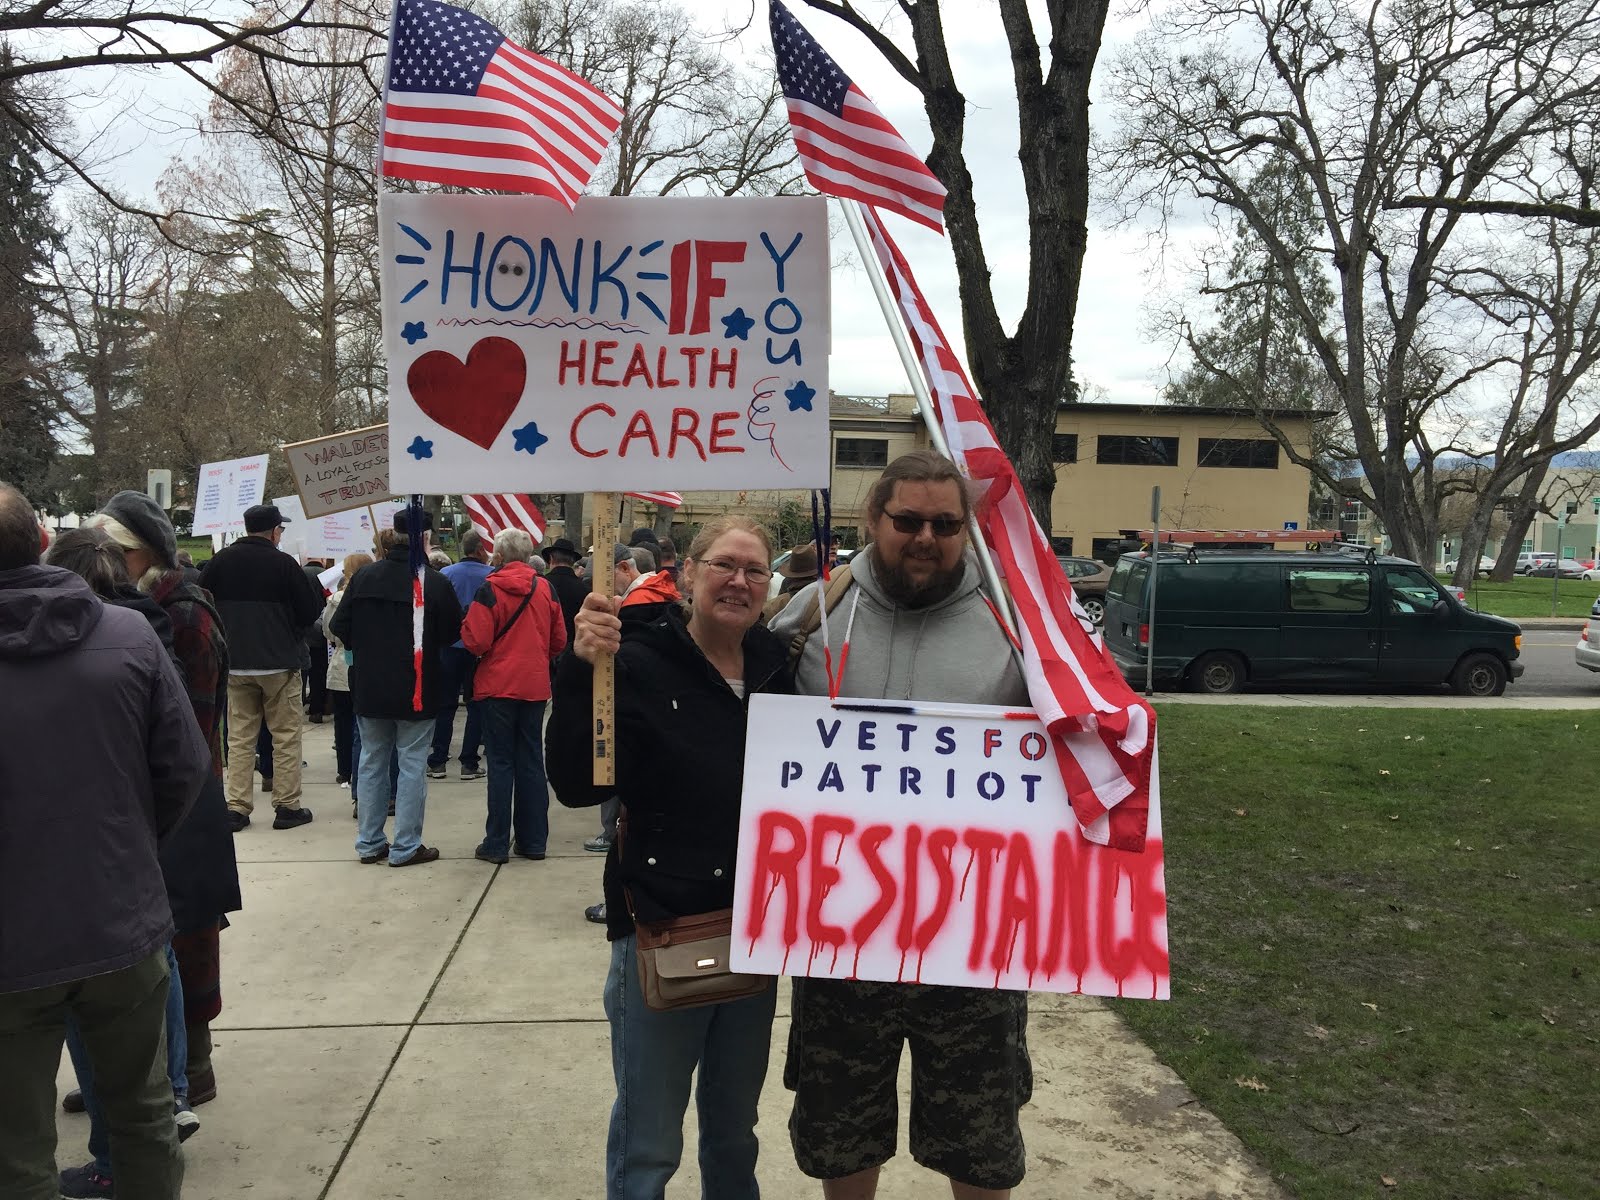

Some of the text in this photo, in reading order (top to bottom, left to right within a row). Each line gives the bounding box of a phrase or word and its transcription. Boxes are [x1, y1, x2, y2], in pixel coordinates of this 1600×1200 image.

[441, 229, 747, 335] HONK IF
[558, 338, 739, 390] HEALTH
[569, 402, 746, 462] CARE
[305, 473, 315, 486] A
[317, 464, 351, 482] LOYAL
[318, 477, 388, 506] TRUM
[342, 474, 361, 486] for
[816, 718, 1047, 762] VETS FO
[780, 761, 1073, 808] PATRIOT
